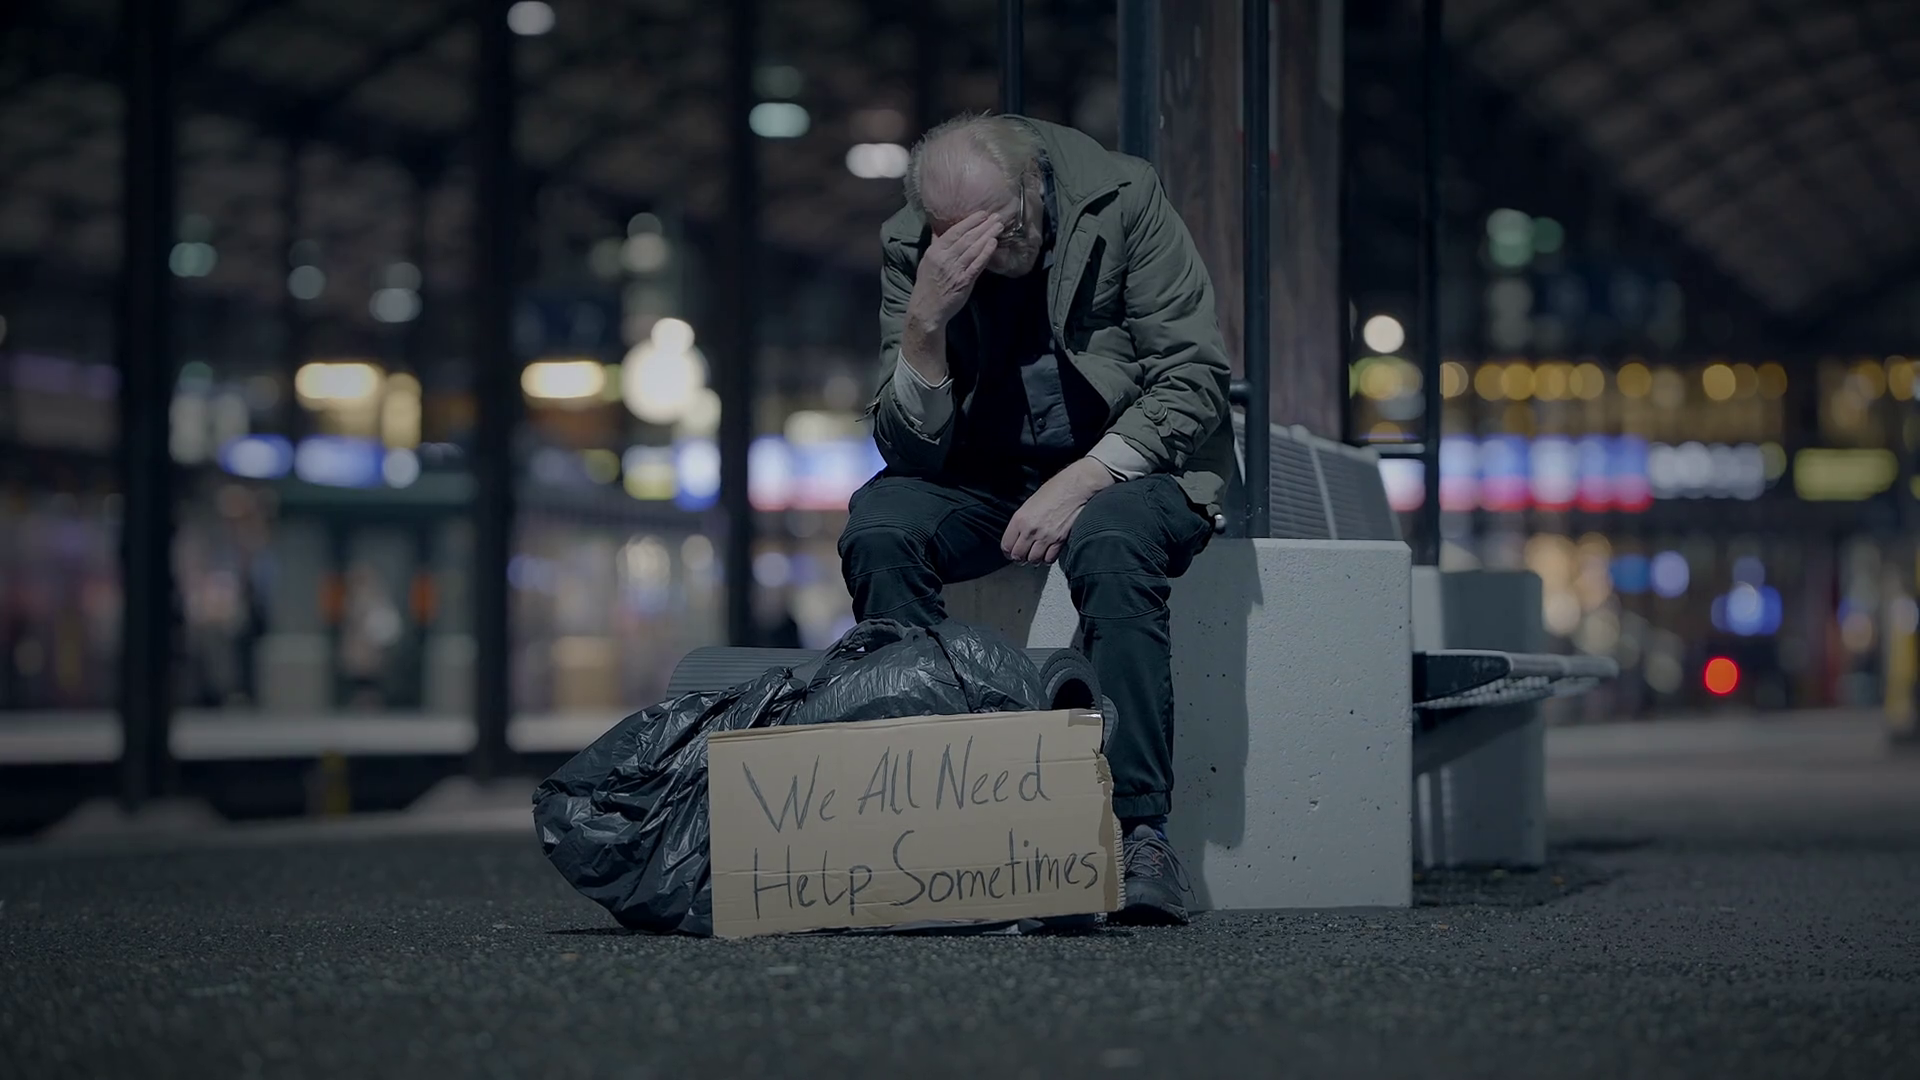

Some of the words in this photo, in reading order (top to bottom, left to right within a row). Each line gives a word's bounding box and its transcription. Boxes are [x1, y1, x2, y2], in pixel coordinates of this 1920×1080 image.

[742, 755, 836, 833] We
[857, 746, 921, 816] All
[935, 734, 1052, 810] Need
[753, 845, 873, 920] Help
[889, 828, 1099, 907] Sometimes
